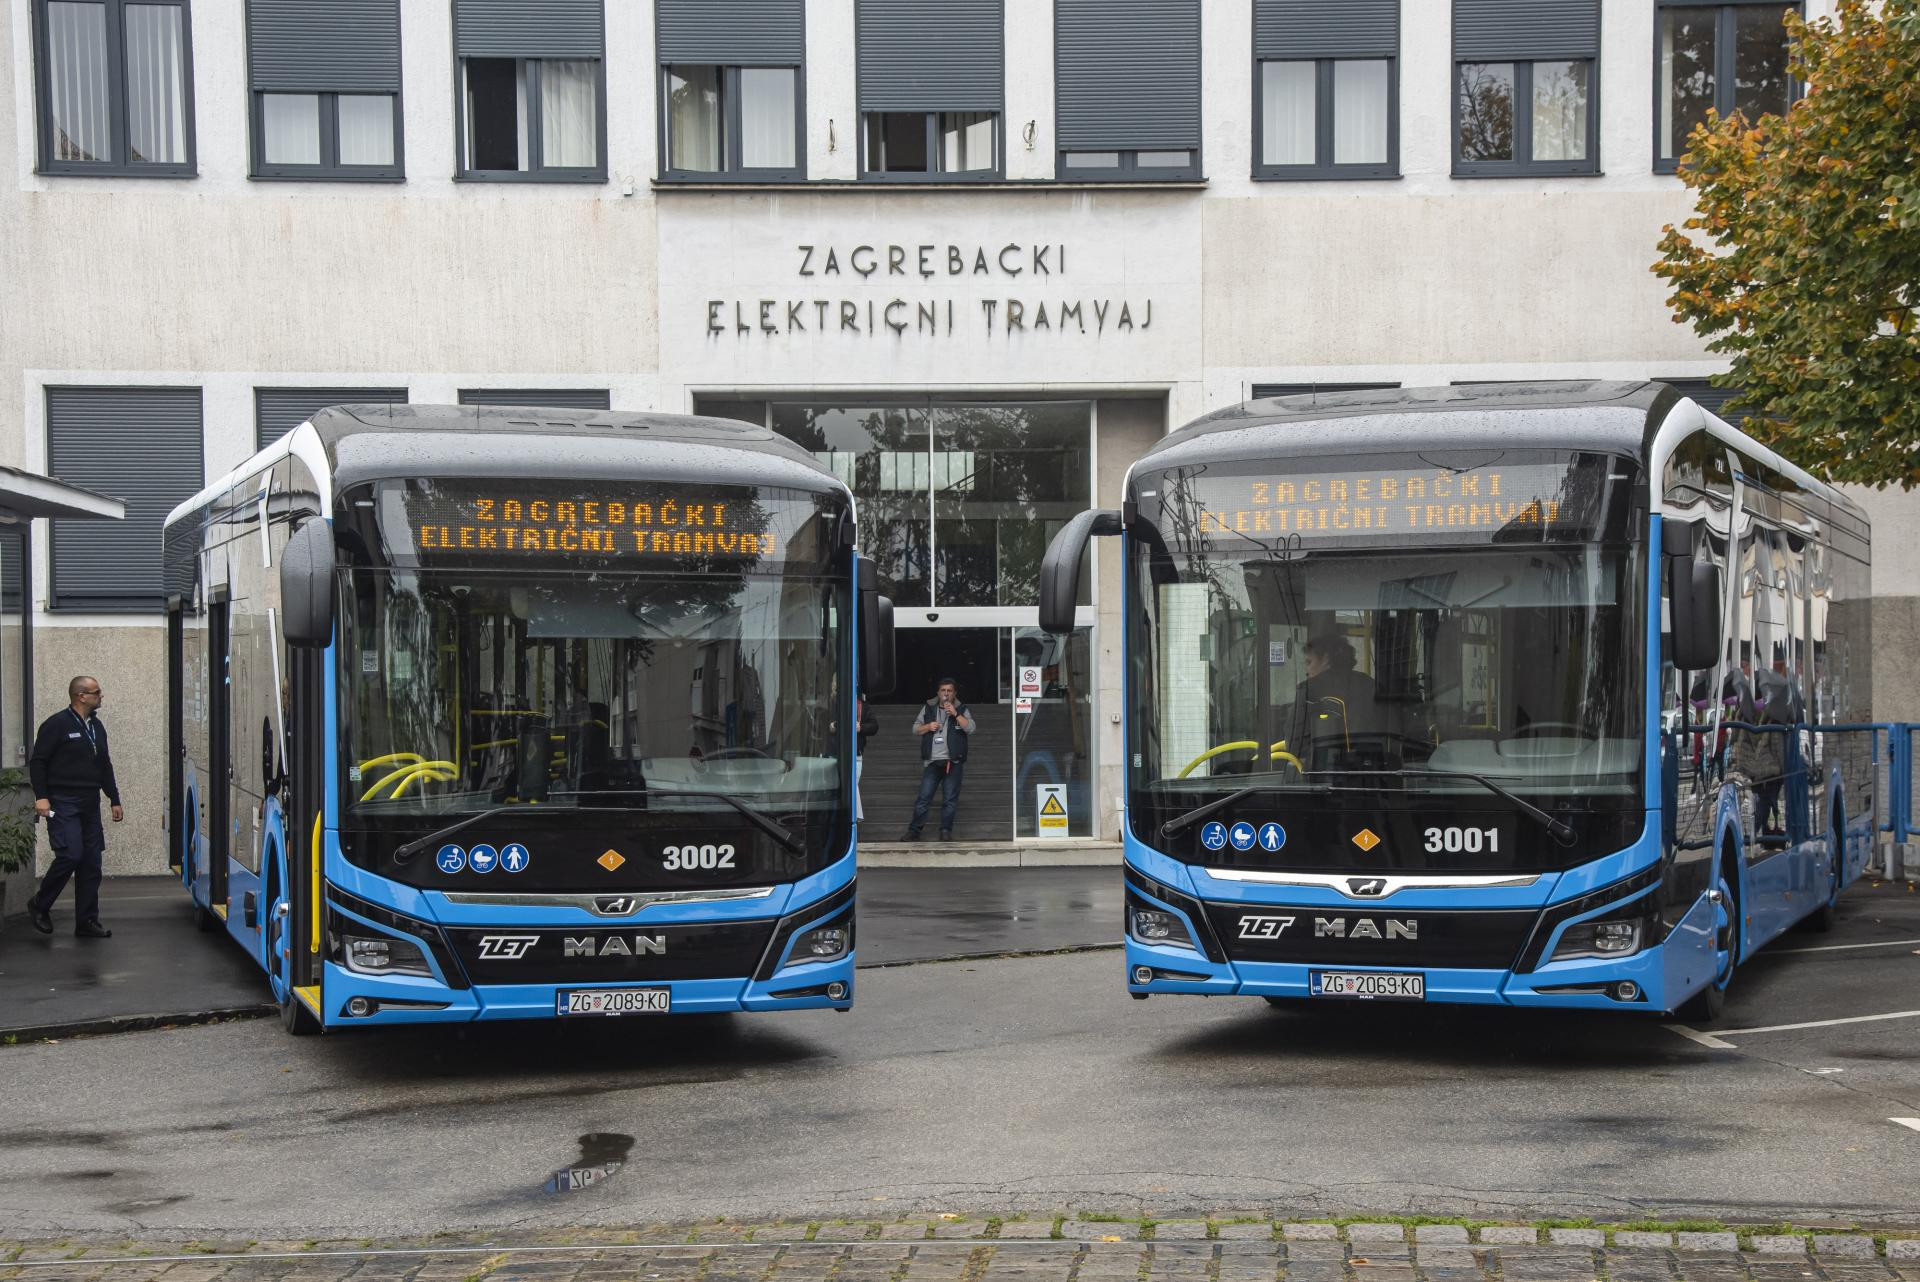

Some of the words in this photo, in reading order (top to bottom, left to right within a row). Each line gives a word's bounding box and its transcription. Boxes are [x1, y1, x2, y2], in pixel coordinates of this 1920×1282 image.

[981, 299, 1151, 330] TRAMVAJ
[1252, 471, 1503, 503] ZAGREBAČKI
[476, 499, 727, 526] ZAGREBAČKI
[1406, 499, 1559, 528] TRAMVAJ
[420, 524, 616, 551] ELEKTRIČNI
[632, 530, 776, 555] TRAMVAJ
[1424, 827, 1498, 853] 3001
[662, 844, 736, 870] 3002
[1238, 915, 1296, 940] ZET
[1314, 917, 1417, 940] MAN
[478, 935, 541, 960] ZET
[563, 935, 666, 957] MAN
[1323, 975, 1344, 993] ZG
[571, 994, 592, 1012] ZG
